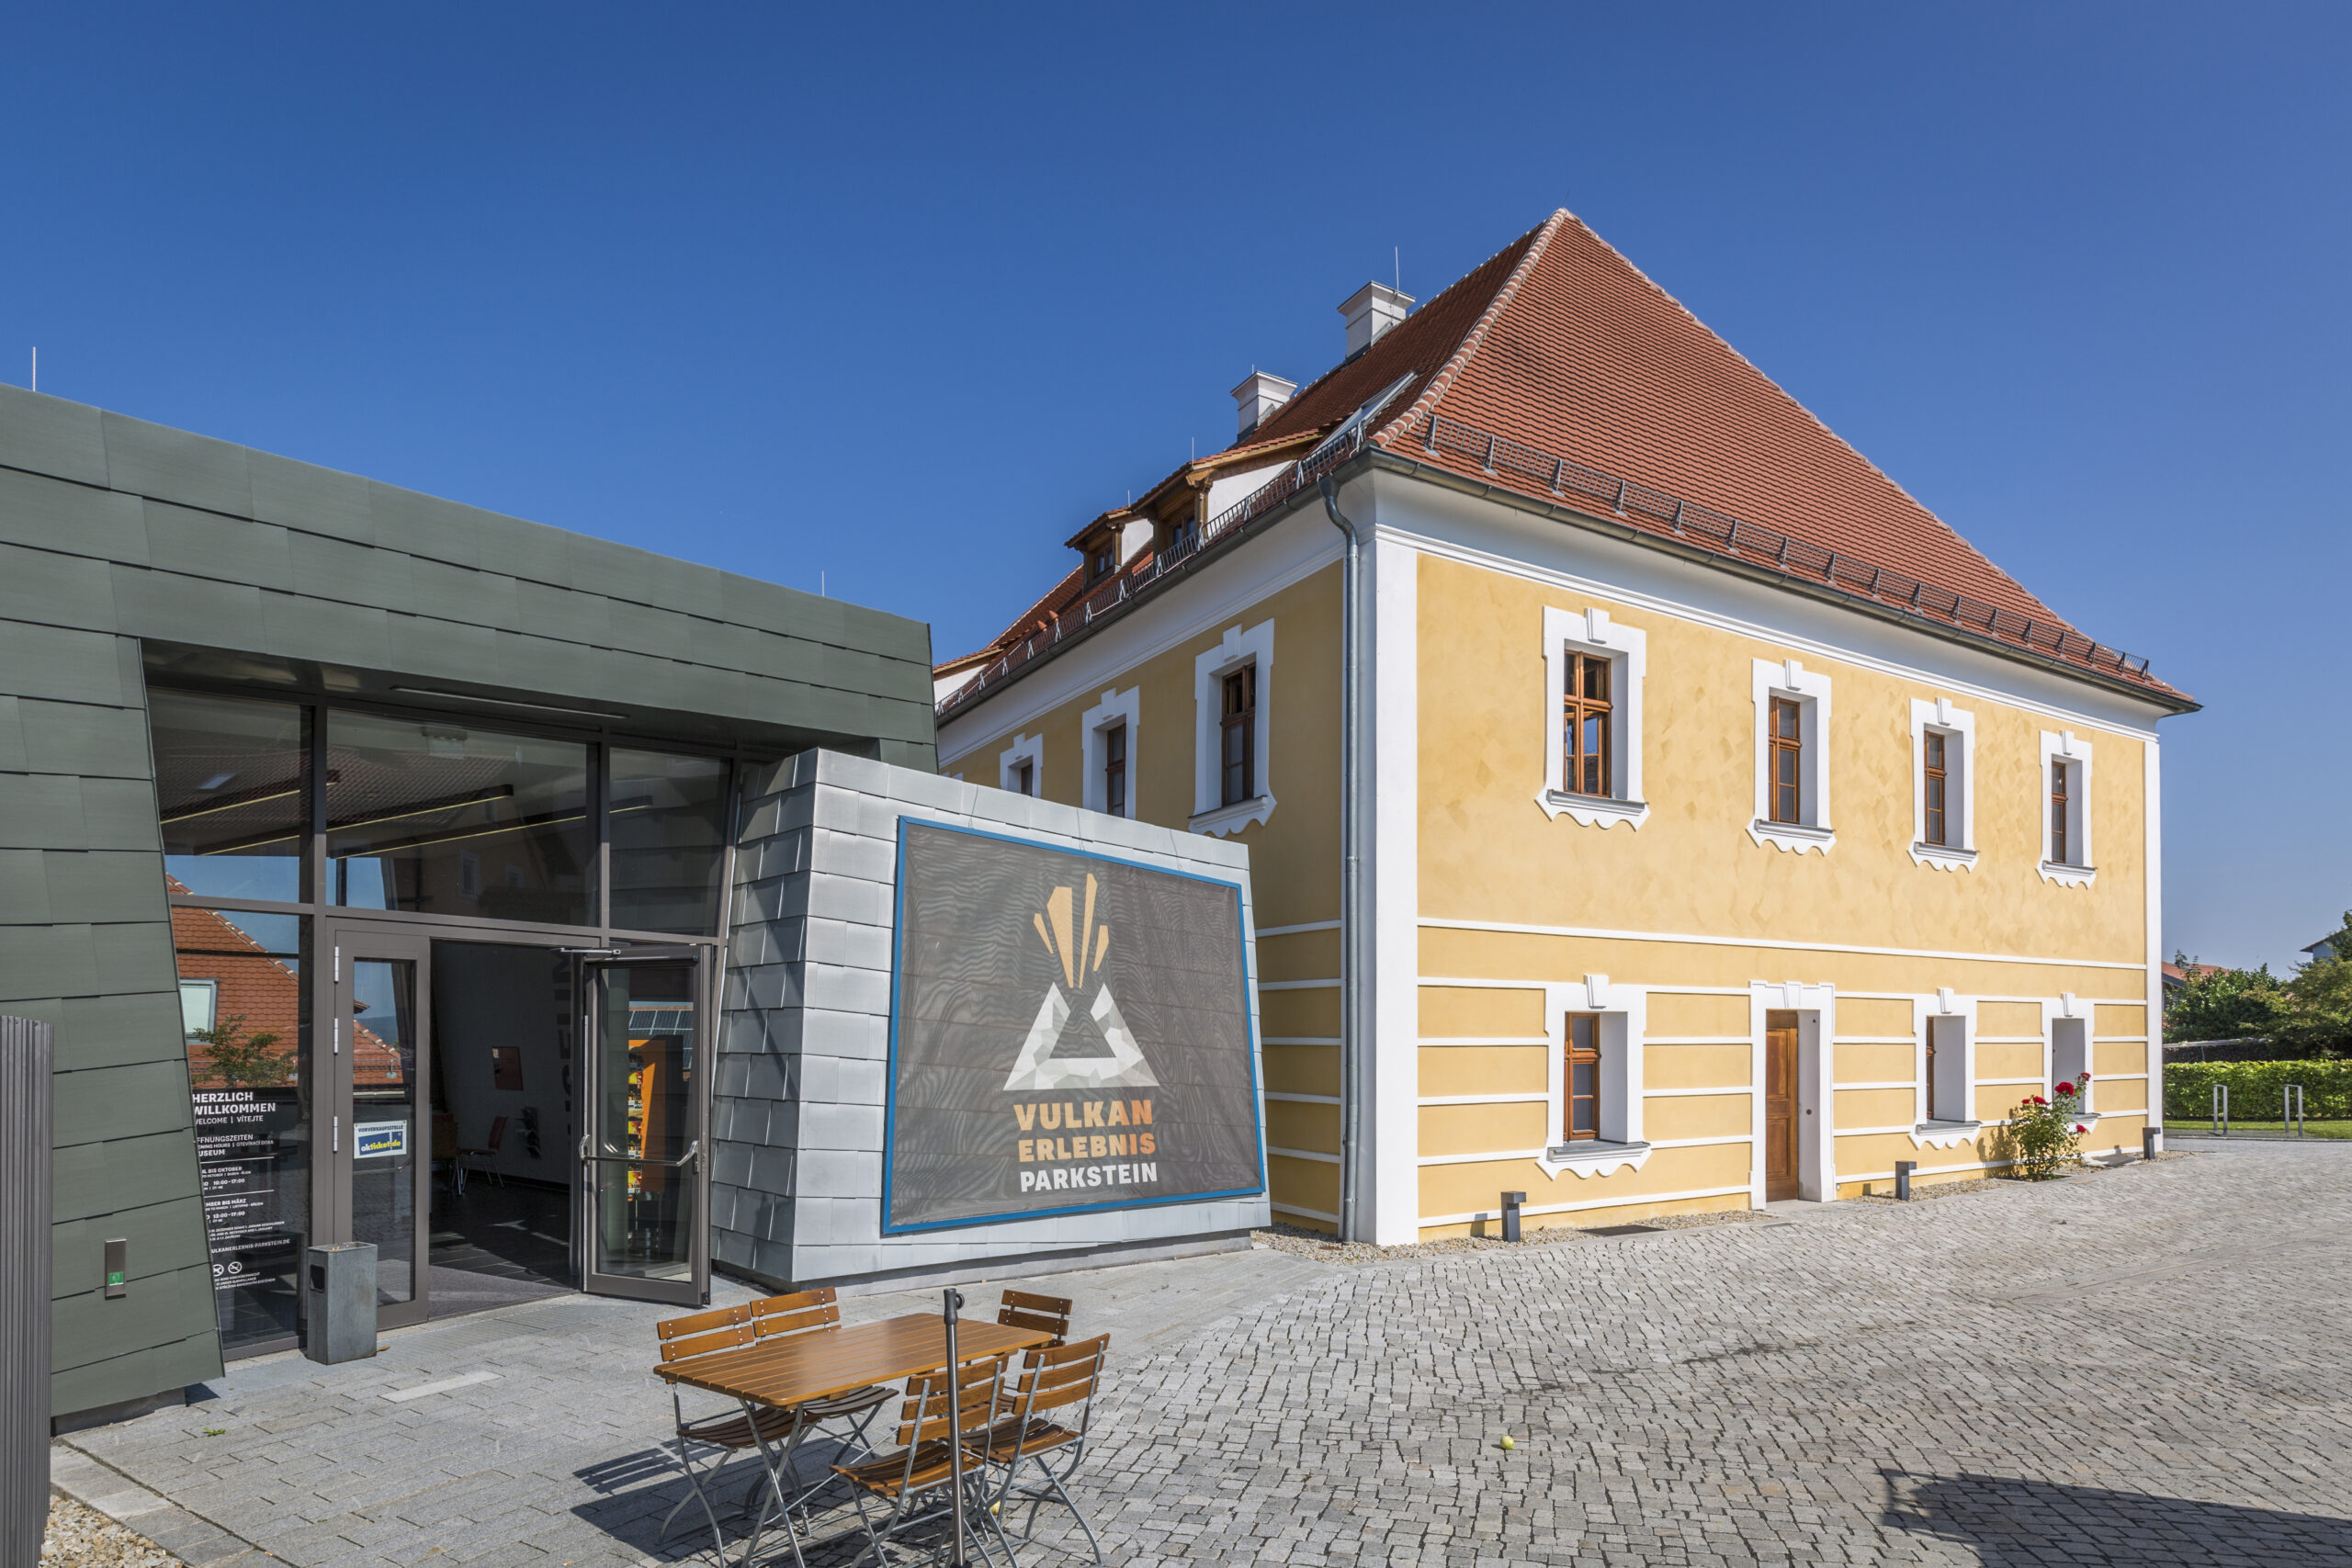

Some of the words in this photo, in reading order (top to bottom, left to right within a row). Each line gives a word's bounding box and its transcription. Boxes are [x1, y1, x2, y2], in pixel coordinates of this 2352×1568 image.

[192, 1091, 254, 1103] HERZLICH
[1013, 1100, 1153, 1131] VULKAN
[358, 1124, 403, 1133] VORVERKAUFSSTELLE
[198, 1148, 226, 1157] USEUM
[1018, 1133, 1157, 1163] ERLEBNIS
[1020, 1162, 1158, 1192] PARKSTEIN
